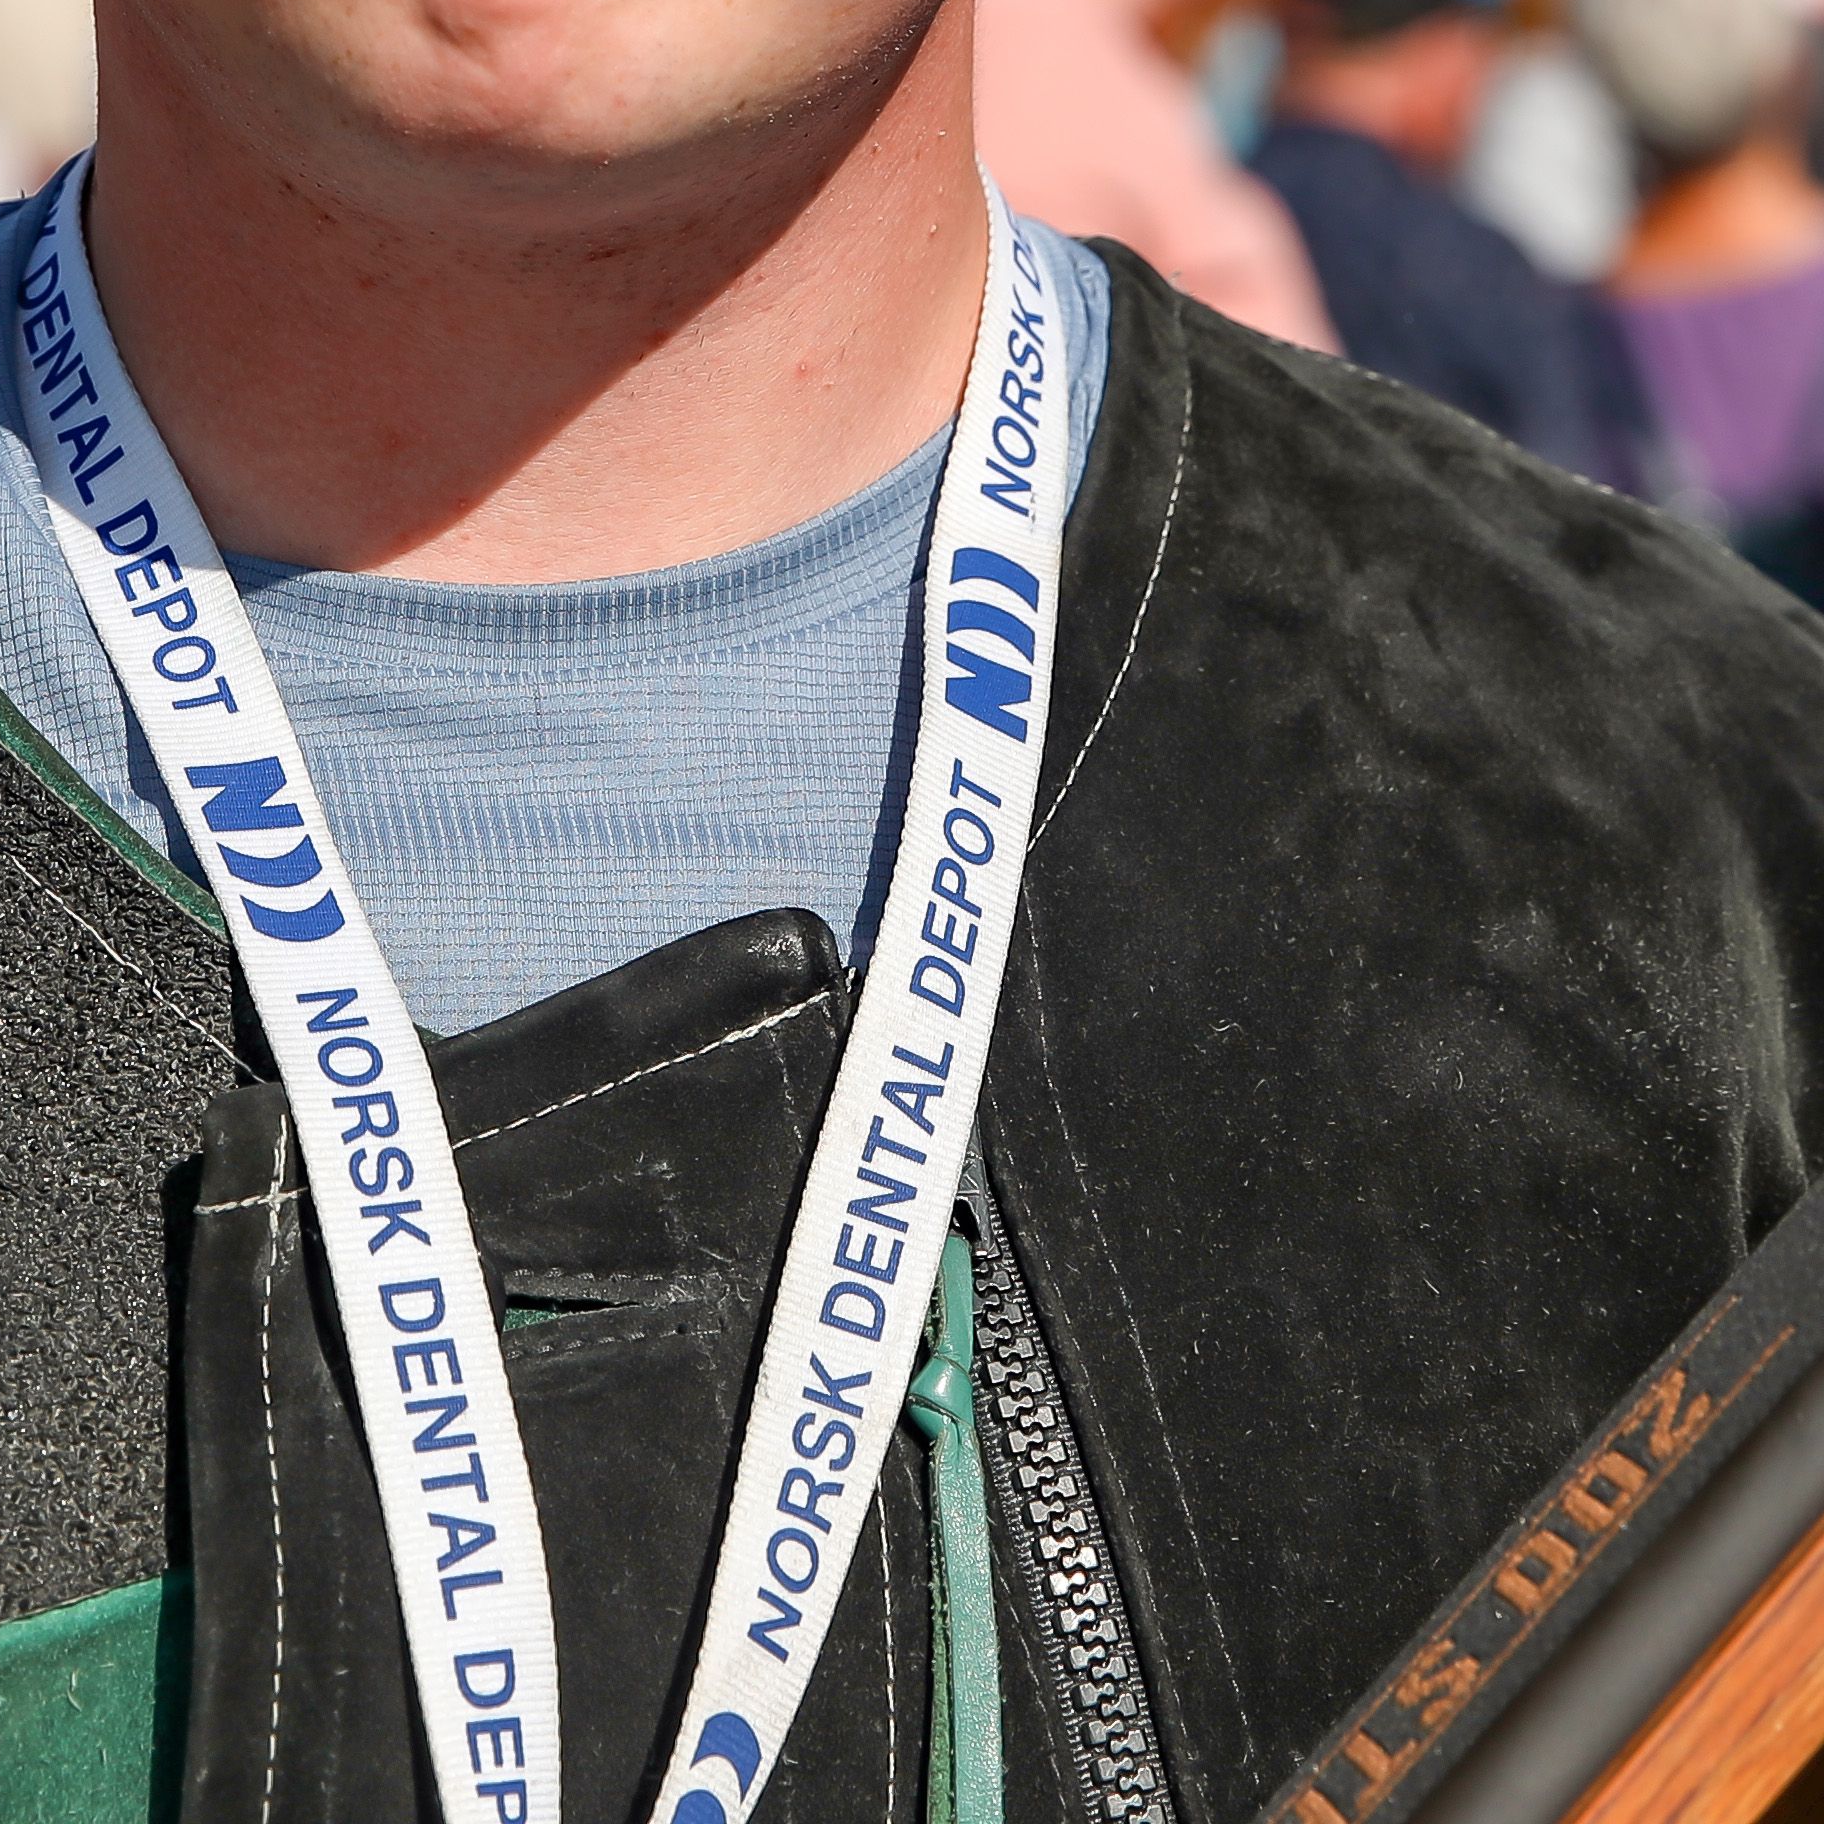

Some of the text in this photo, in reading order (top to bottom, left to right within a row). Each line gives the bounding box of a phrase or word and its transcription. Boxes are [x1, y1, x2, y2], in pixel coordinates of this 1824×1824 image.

[18, 251, 125, 507] DENTAL
[96, 497, 239, 716] DEPOT
[295, 986, 433, 1256] NORSK
[378, 1277, 505, 1622] DENTAL
[746, 1355, 870, 1664] NORSK
[821, 1041, 954, 1343] DENTAL
[909, 756, 1005, 1017] DEPOT
[980, 282, 1046, 518] NORSK
[1286, 1367, 1712, 1824] 200 ST
